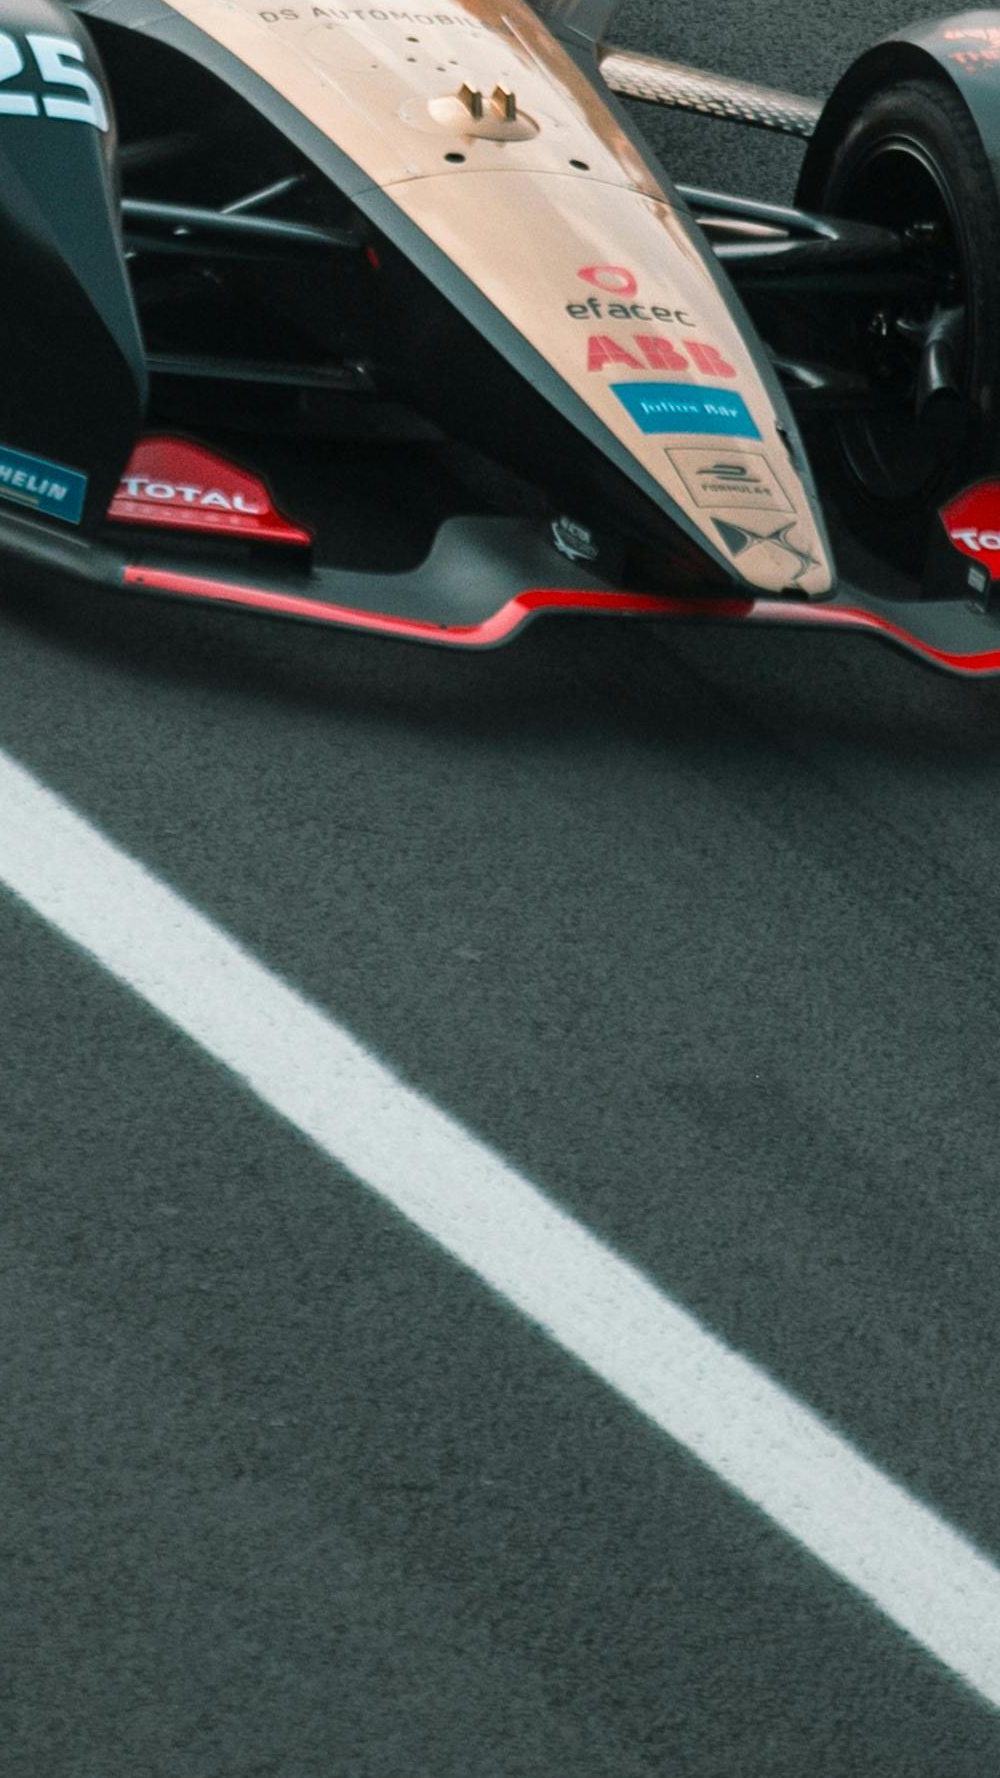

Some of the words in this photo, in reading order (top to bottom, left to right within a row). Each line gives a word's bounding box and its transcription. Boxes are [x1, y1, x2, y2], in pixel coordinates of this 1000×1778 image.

[258, 7, 300, 23] DS
[312, 6, 483, 30] AUTOMOBIL
[565, 297, 697, 328] efacec
[587, 334, 738, 379] ABB
[120, 477, 261, 515] TOTAL
